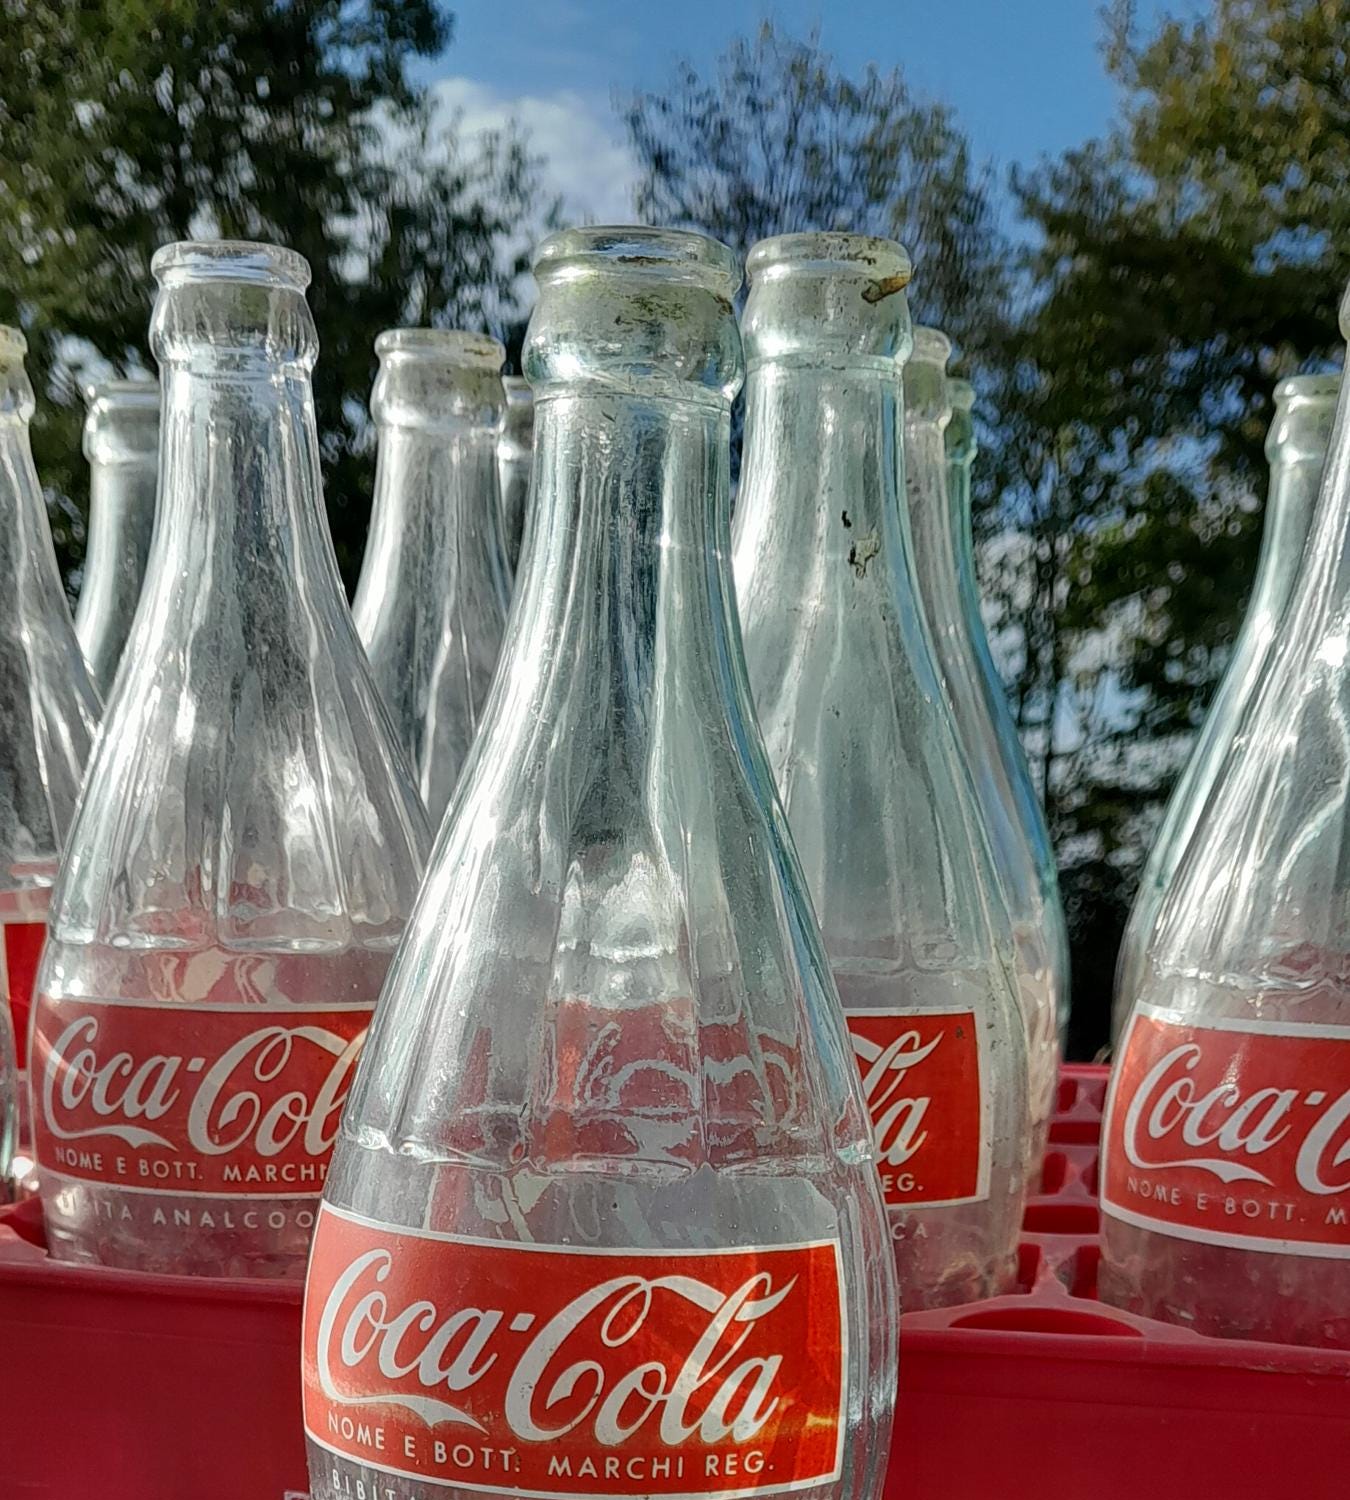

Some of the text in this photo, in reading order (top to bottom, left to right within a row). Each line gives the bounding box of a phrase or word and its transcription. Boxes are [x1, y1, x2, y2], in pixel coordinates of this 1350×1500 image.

[44, 1016, 370, 1156] Coca-Col
[55, 1147, 103, 1171] NOME
[116, 1156, 127, 1174] E
[140, 1158, 204, 1180] BOTT.
[881, 1173, 924, 1192] EG.
[153, 1207, 314, 1230] ANALCOO
[1128, 1176, 1181, 1205] NOME
[1197, 1193, 1208, 1210] E
[1225, 1197, 1304, 1221] BOTT.
[317, 1248, 799, 1446] Coca-Cola
[328, 1410, 774, 1479] NOME E BOTT. MARCHI REG.
